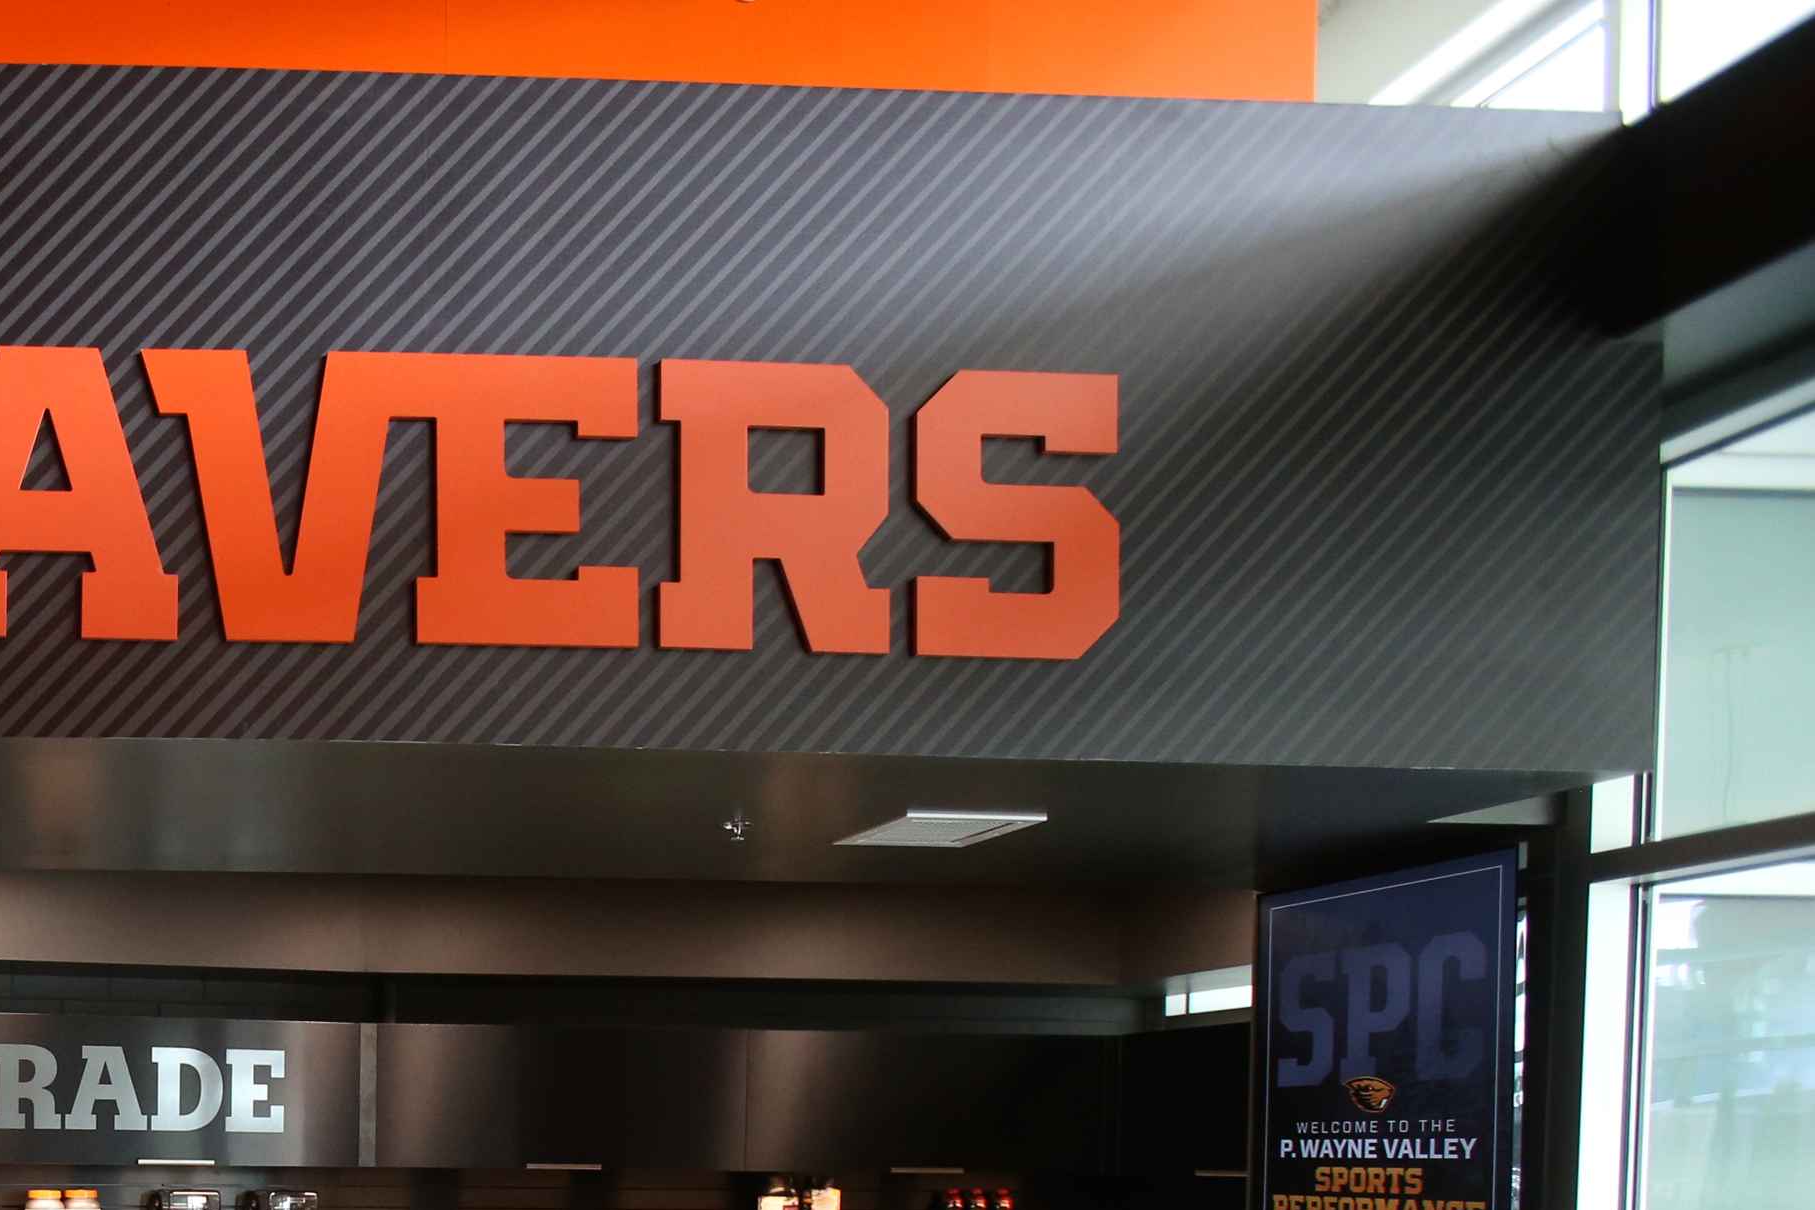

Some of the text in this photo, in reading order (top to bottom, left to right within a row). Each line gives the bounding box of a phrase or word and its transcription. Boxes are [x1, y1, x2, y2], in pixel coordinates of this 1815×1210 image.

[1277, 931, 1487, 1087] SPC
[1296, 1119, 1455, 1134] WELCOME TO THE
[1299, 1138, 1378, 1158] WAYNE
[1382, 1137, 1477, 1159] VALLEY
[1315, 1166, 1423, 1195] SPORTS
